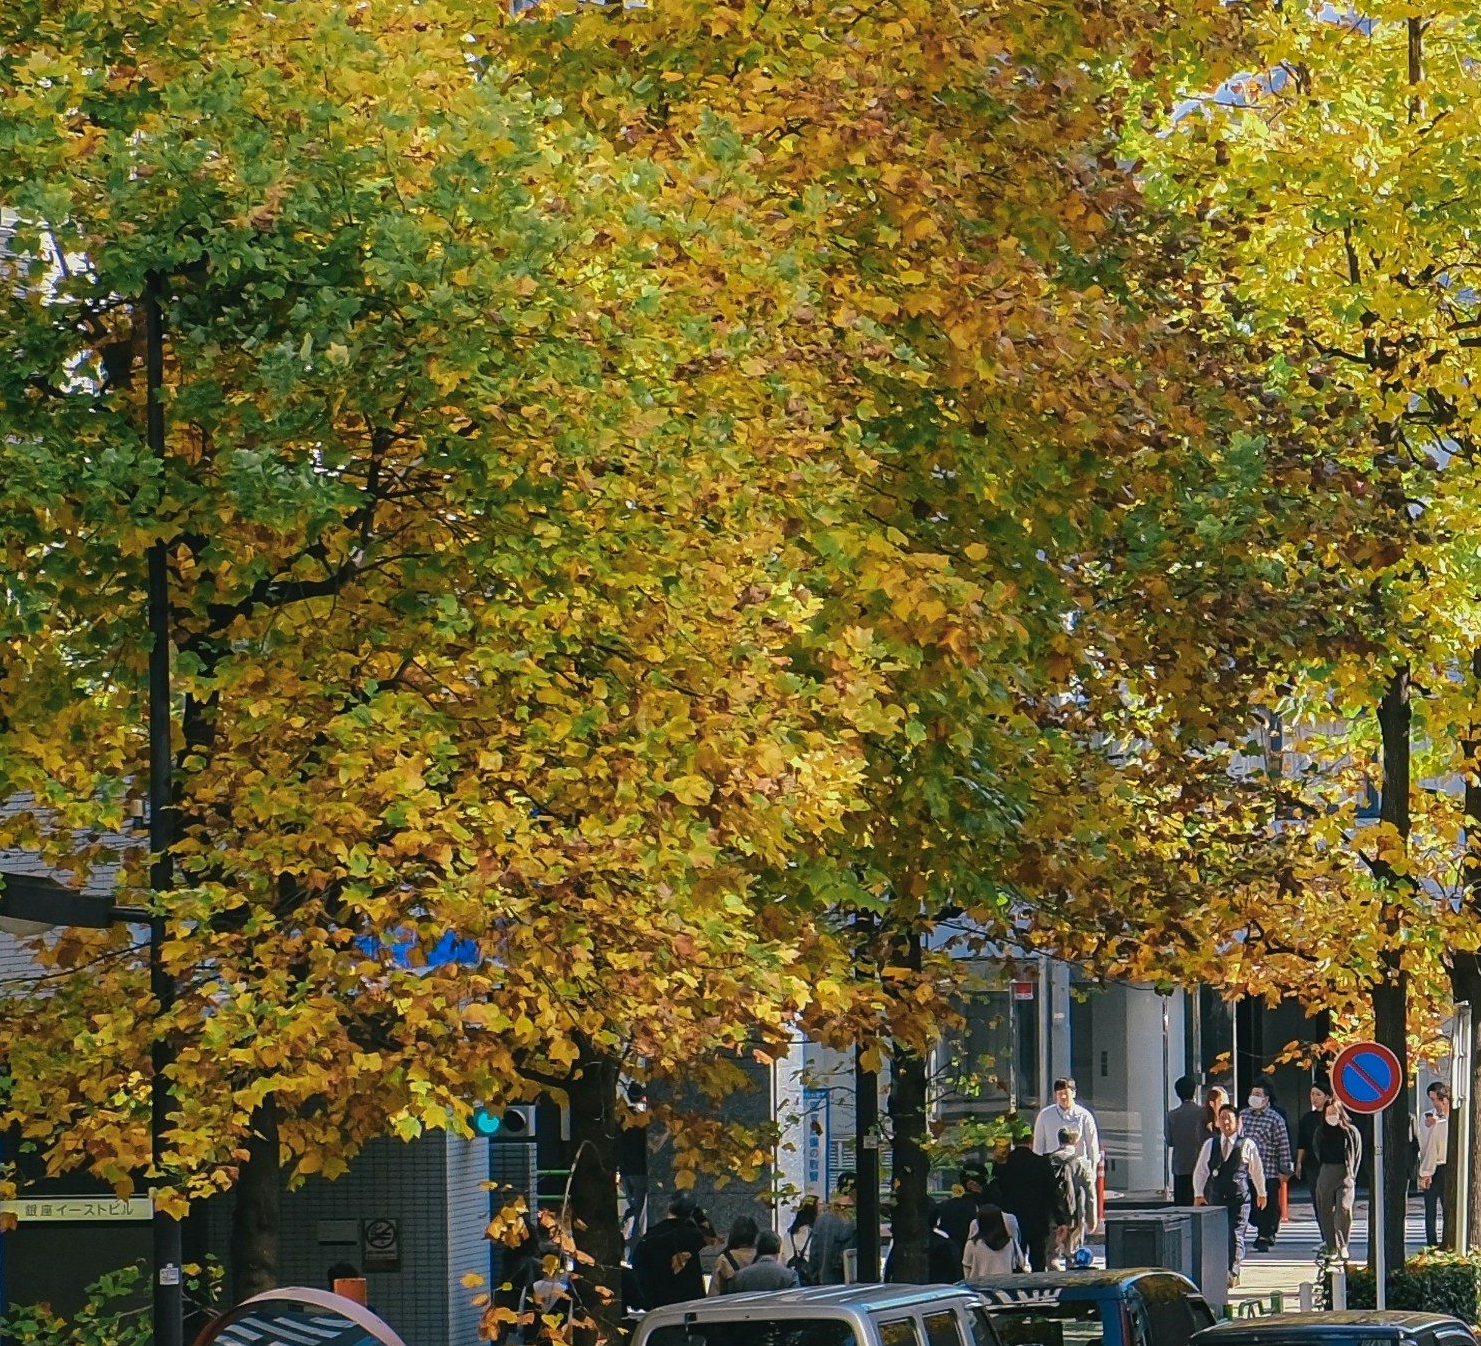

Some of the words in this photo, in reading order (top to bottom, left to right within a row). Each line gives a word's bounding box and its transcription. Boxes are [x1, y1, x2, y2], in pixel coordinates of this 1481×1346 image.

[25, 1203, 134, 1217] 銀座イーストビル
